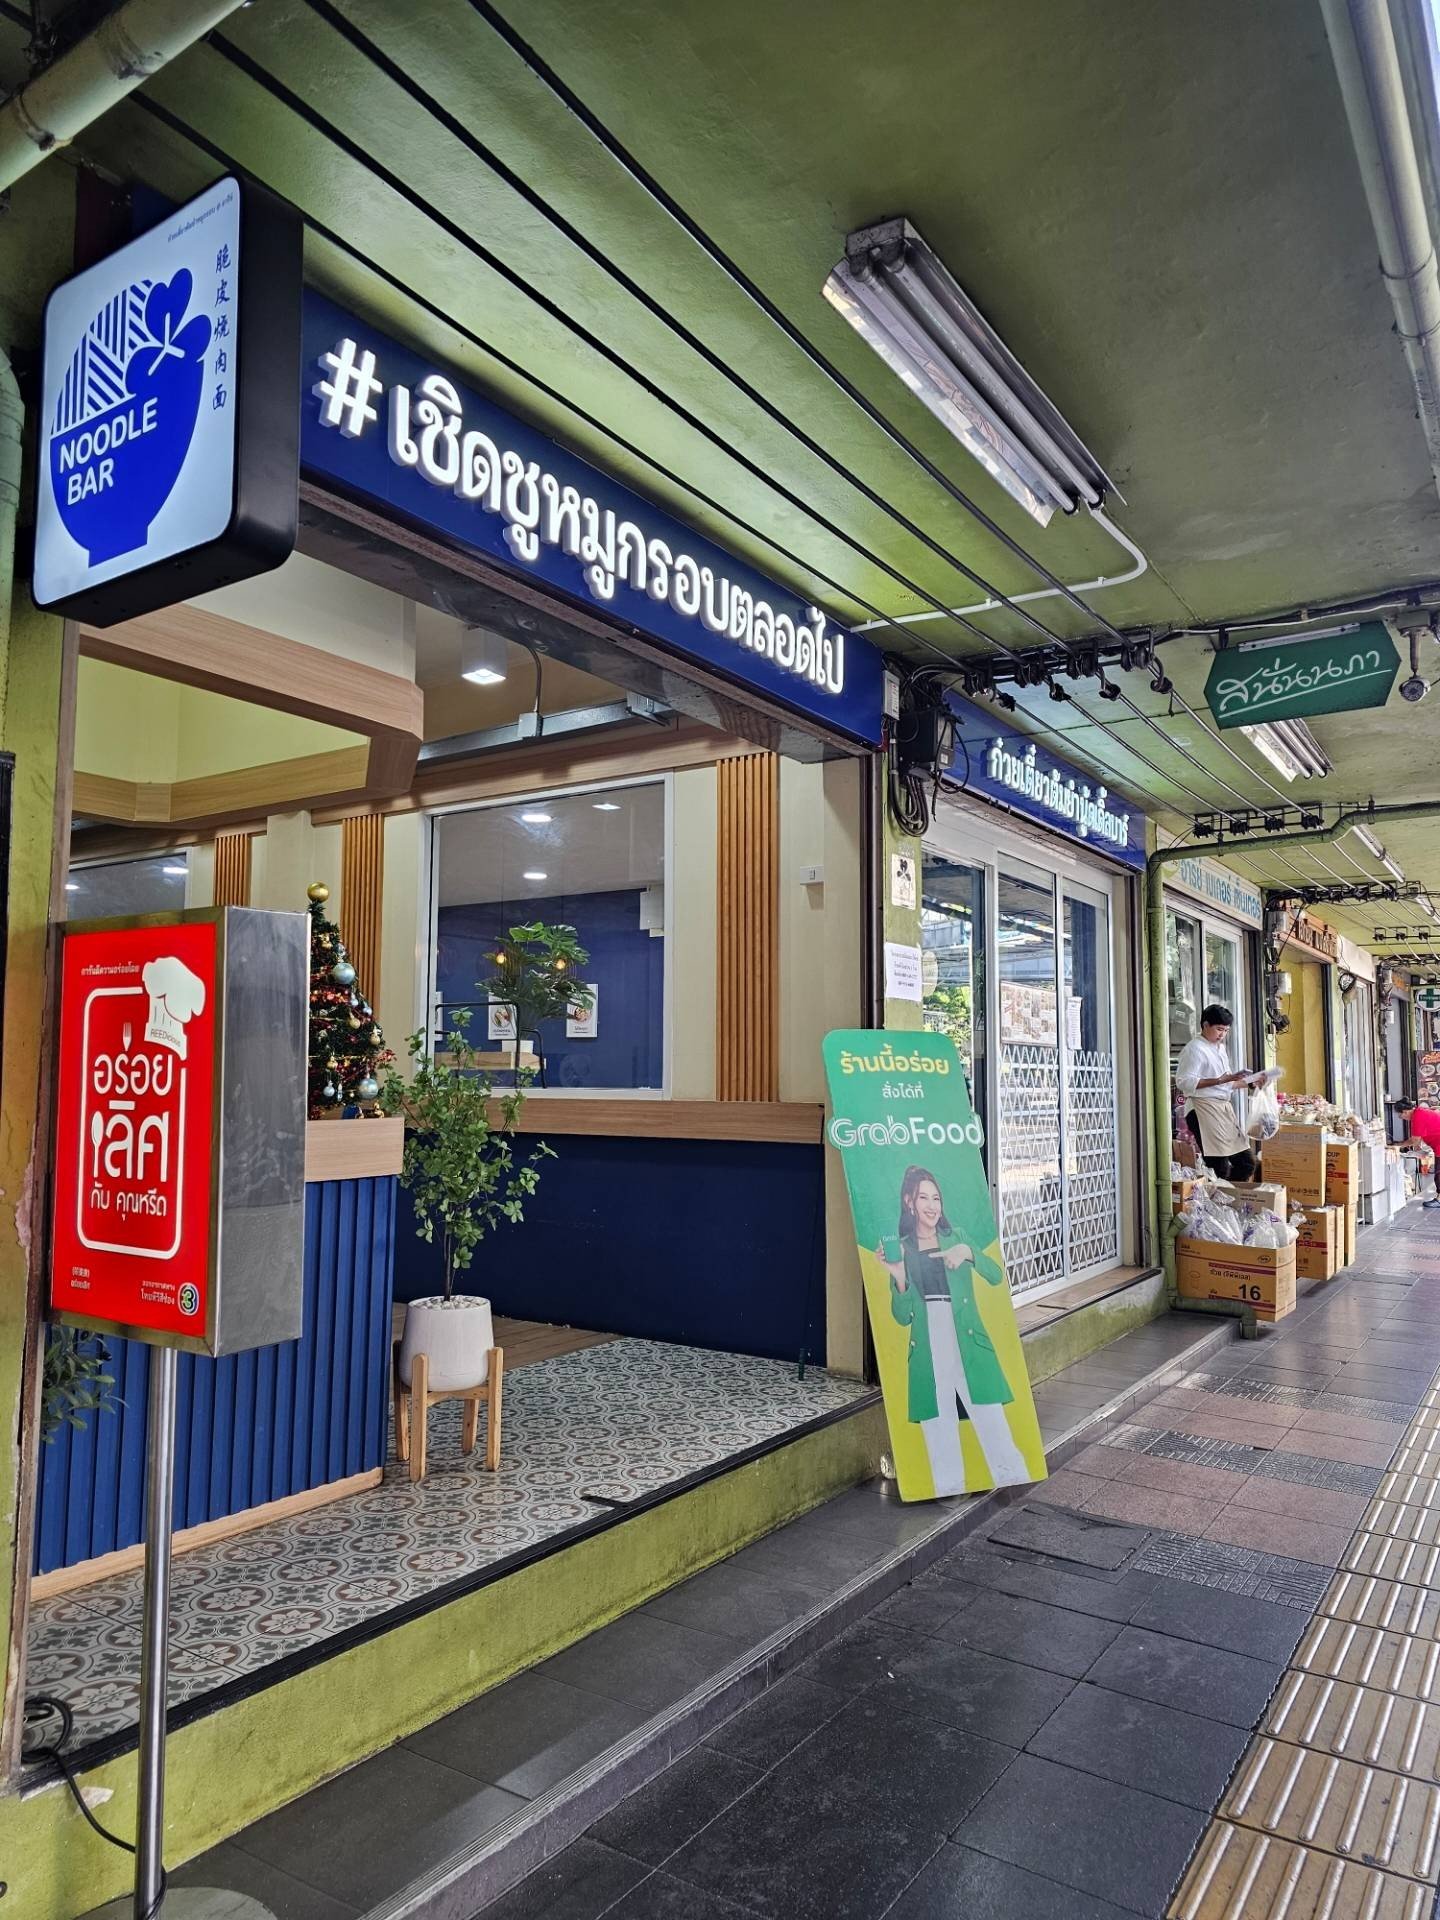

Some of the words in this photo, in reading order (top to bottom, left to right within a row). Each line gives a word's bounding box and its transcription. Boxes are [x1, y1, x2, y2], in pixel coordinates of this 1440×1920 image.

[60, 397, 159, 474] NOODLE
[67, 458, 114, 506] BAR
[312, 337, 846, 694] #เชิดชูหมูกรอบตลอดไป
[94, 1023, 173, 1096] อร่อย
[841, 1043, 949, 1075] ร้านนี้อร่อย
[882, 1080, 924, 1099] สั่งได้ที่
[91, 1100, 170, 1183] เลิศ
[830, 1114, 983, 1148] GrabFood
[91, 1181, 110, 1209] กับ
[1238, 1283, 1261, 1301] 16
